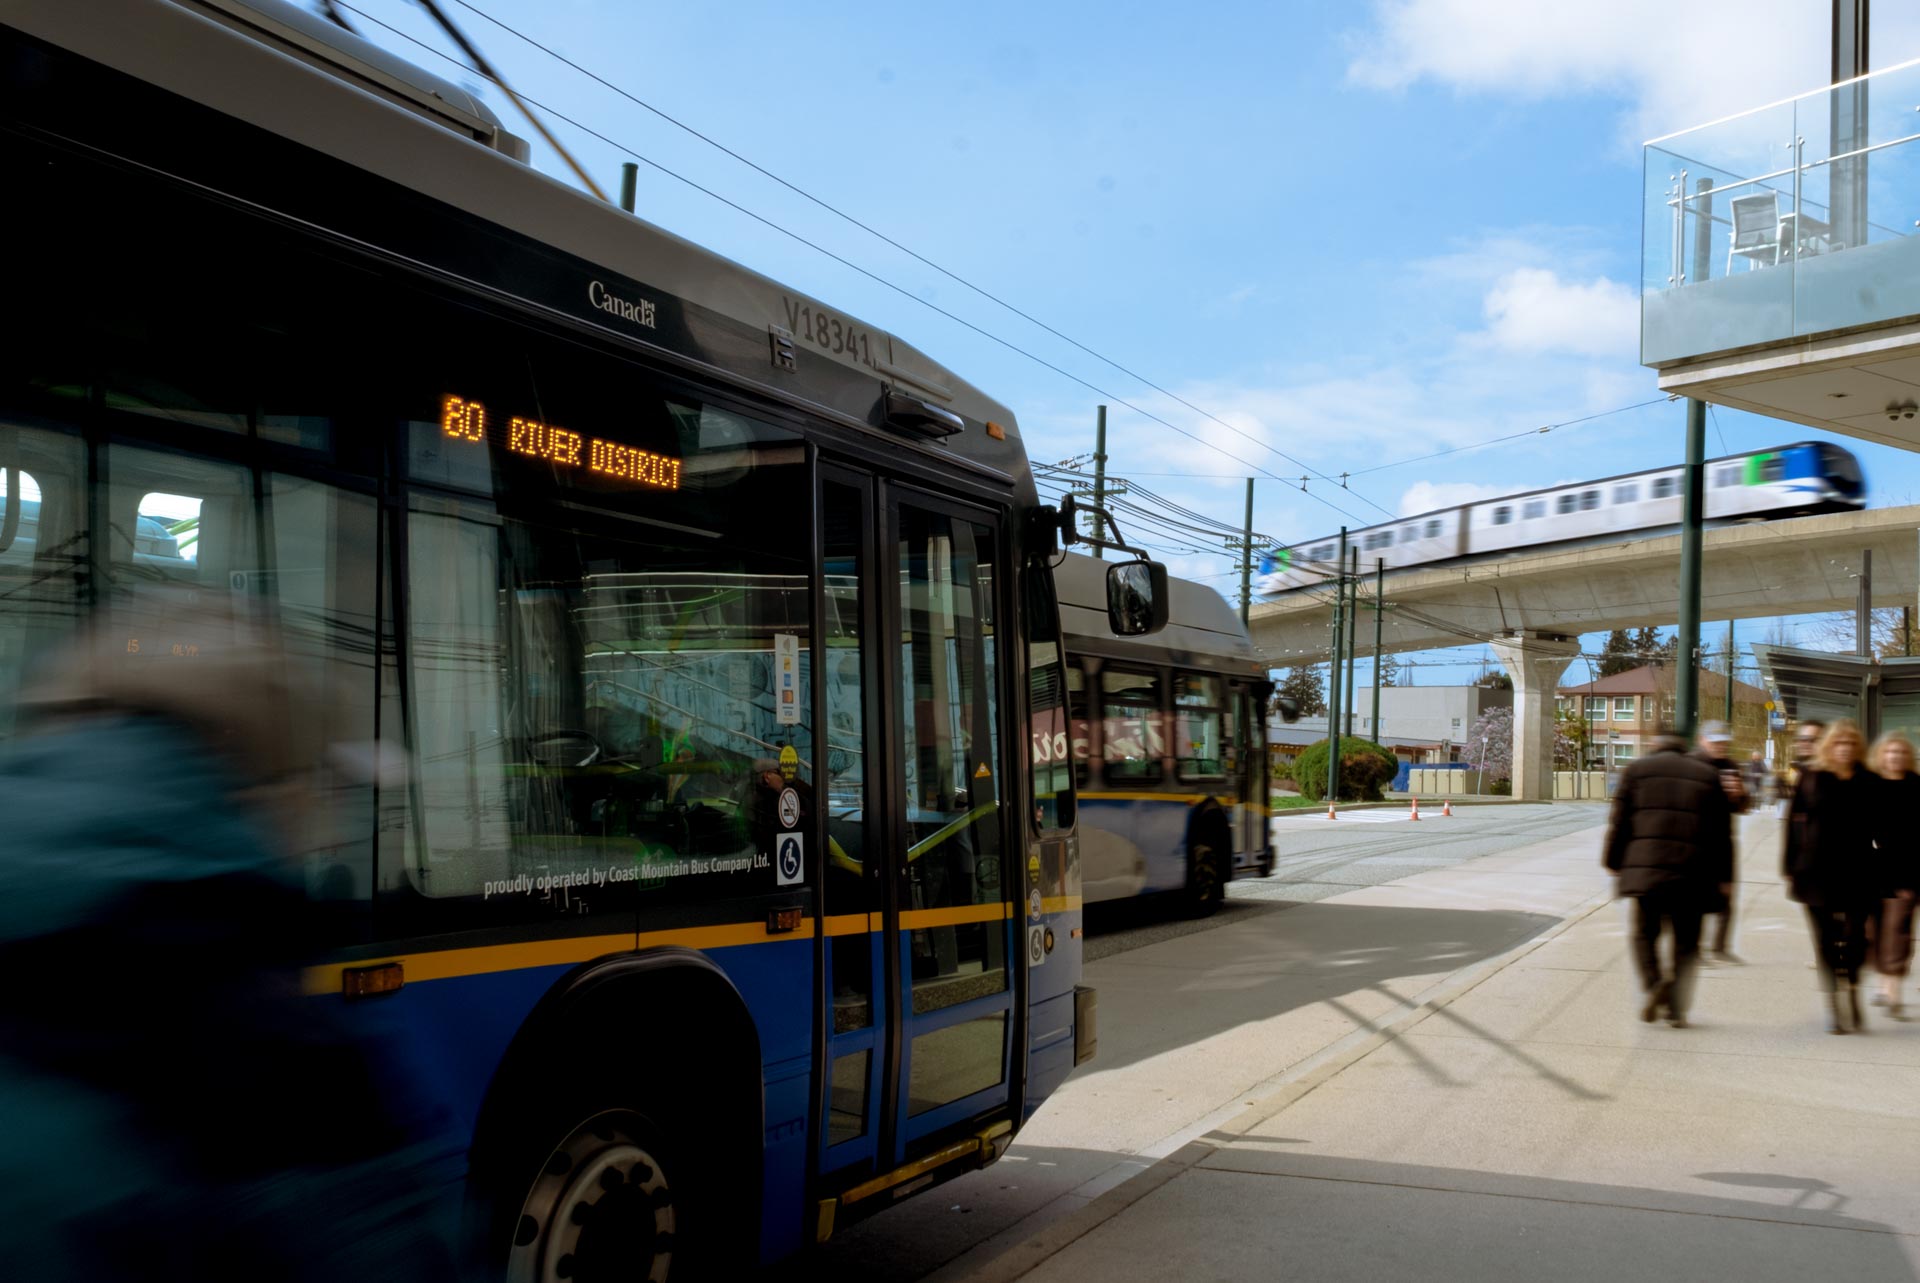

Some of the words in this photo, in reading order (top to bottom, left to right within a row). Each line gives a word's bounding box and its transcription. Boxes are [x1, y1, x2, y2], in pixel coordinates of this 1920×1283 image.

[588, 280, 656, 329] Canada
[783, 295, 872, 367] V18341
[443, 397, 484, 442] 80
[511, 418, 581, 466] RIVER
[591, 439, 680, 489] DISTRICT
[484, 873, 534, 900] proudly
[536, 867, 590, 894] operated
[592, 867, 607, 888] by
[608, 865, 638, 883] Coast
[641, 860, 689, 879] Mountain
[691, 859, 709, 874] Bus
[711, 856, 752, 875] Company
[753, 851, 770, 868] Ltd.
